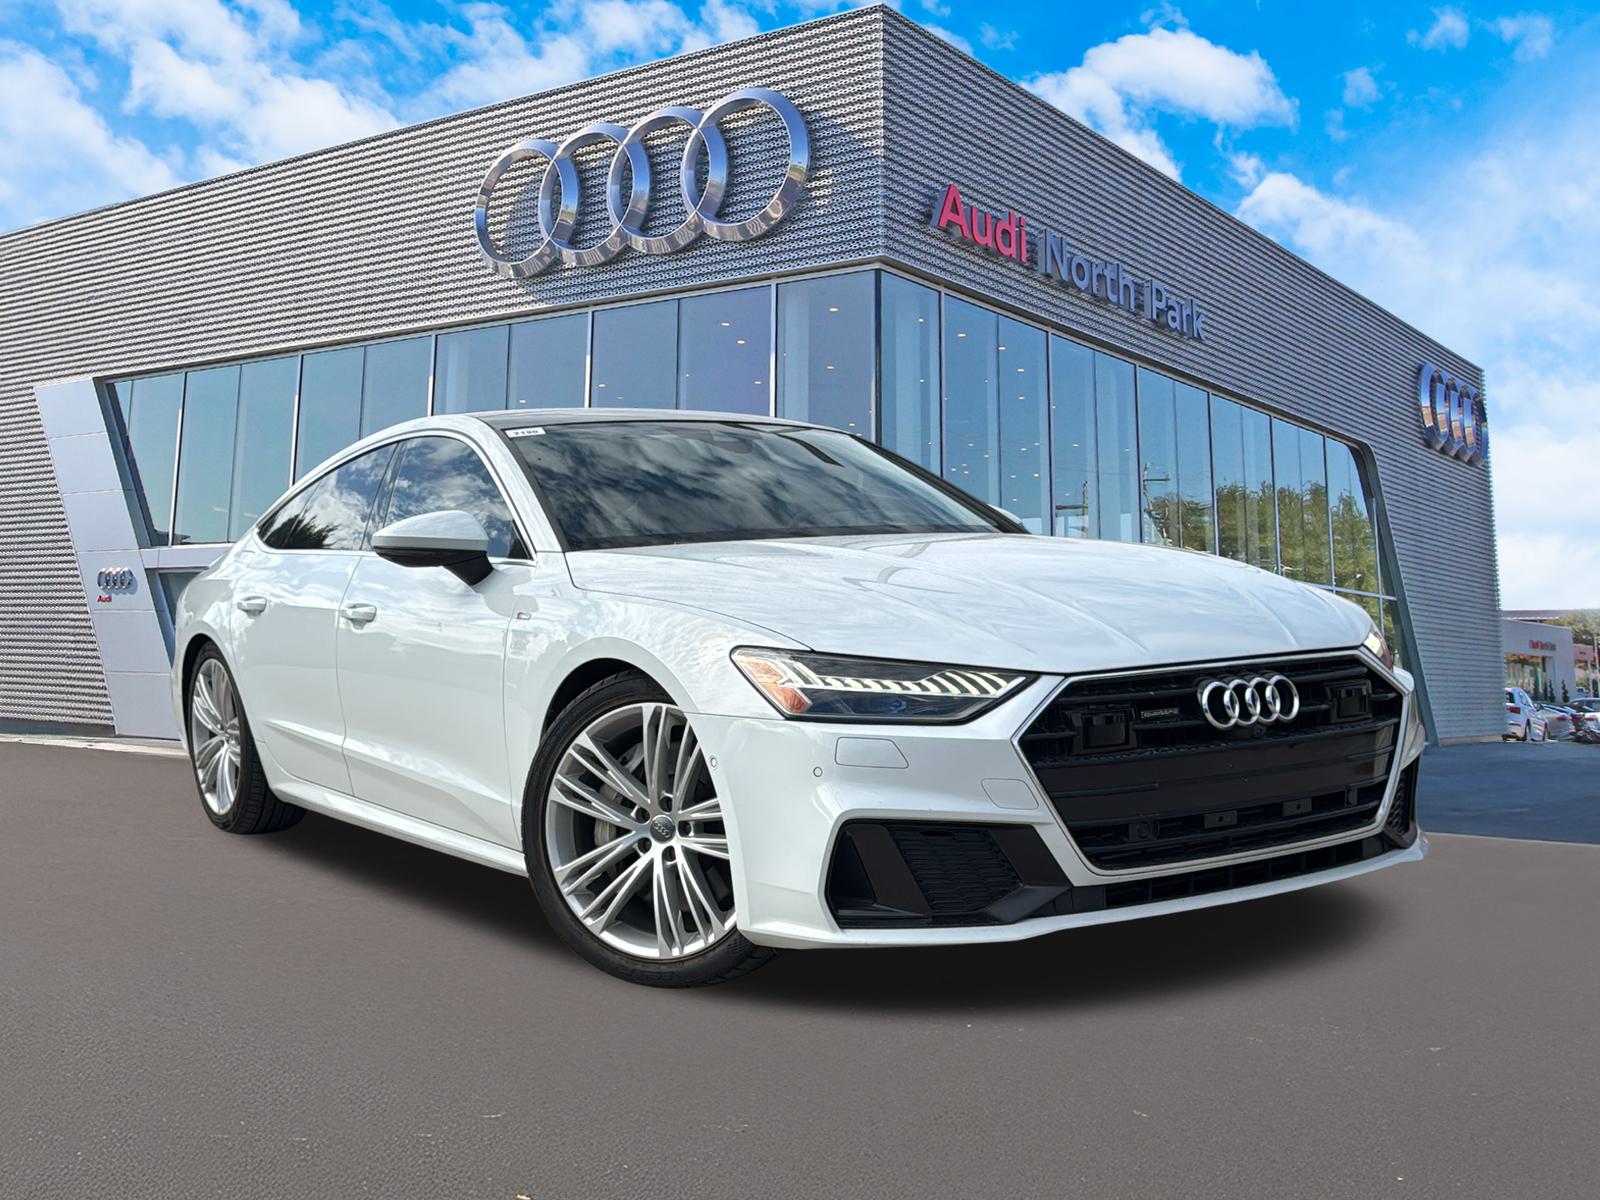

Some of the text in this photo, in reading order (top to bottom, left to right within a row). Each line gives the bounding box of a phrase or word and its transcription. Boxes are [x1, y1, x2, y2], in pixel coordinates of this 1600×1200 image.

[935, 183, 1207, 341] Audi North Park
